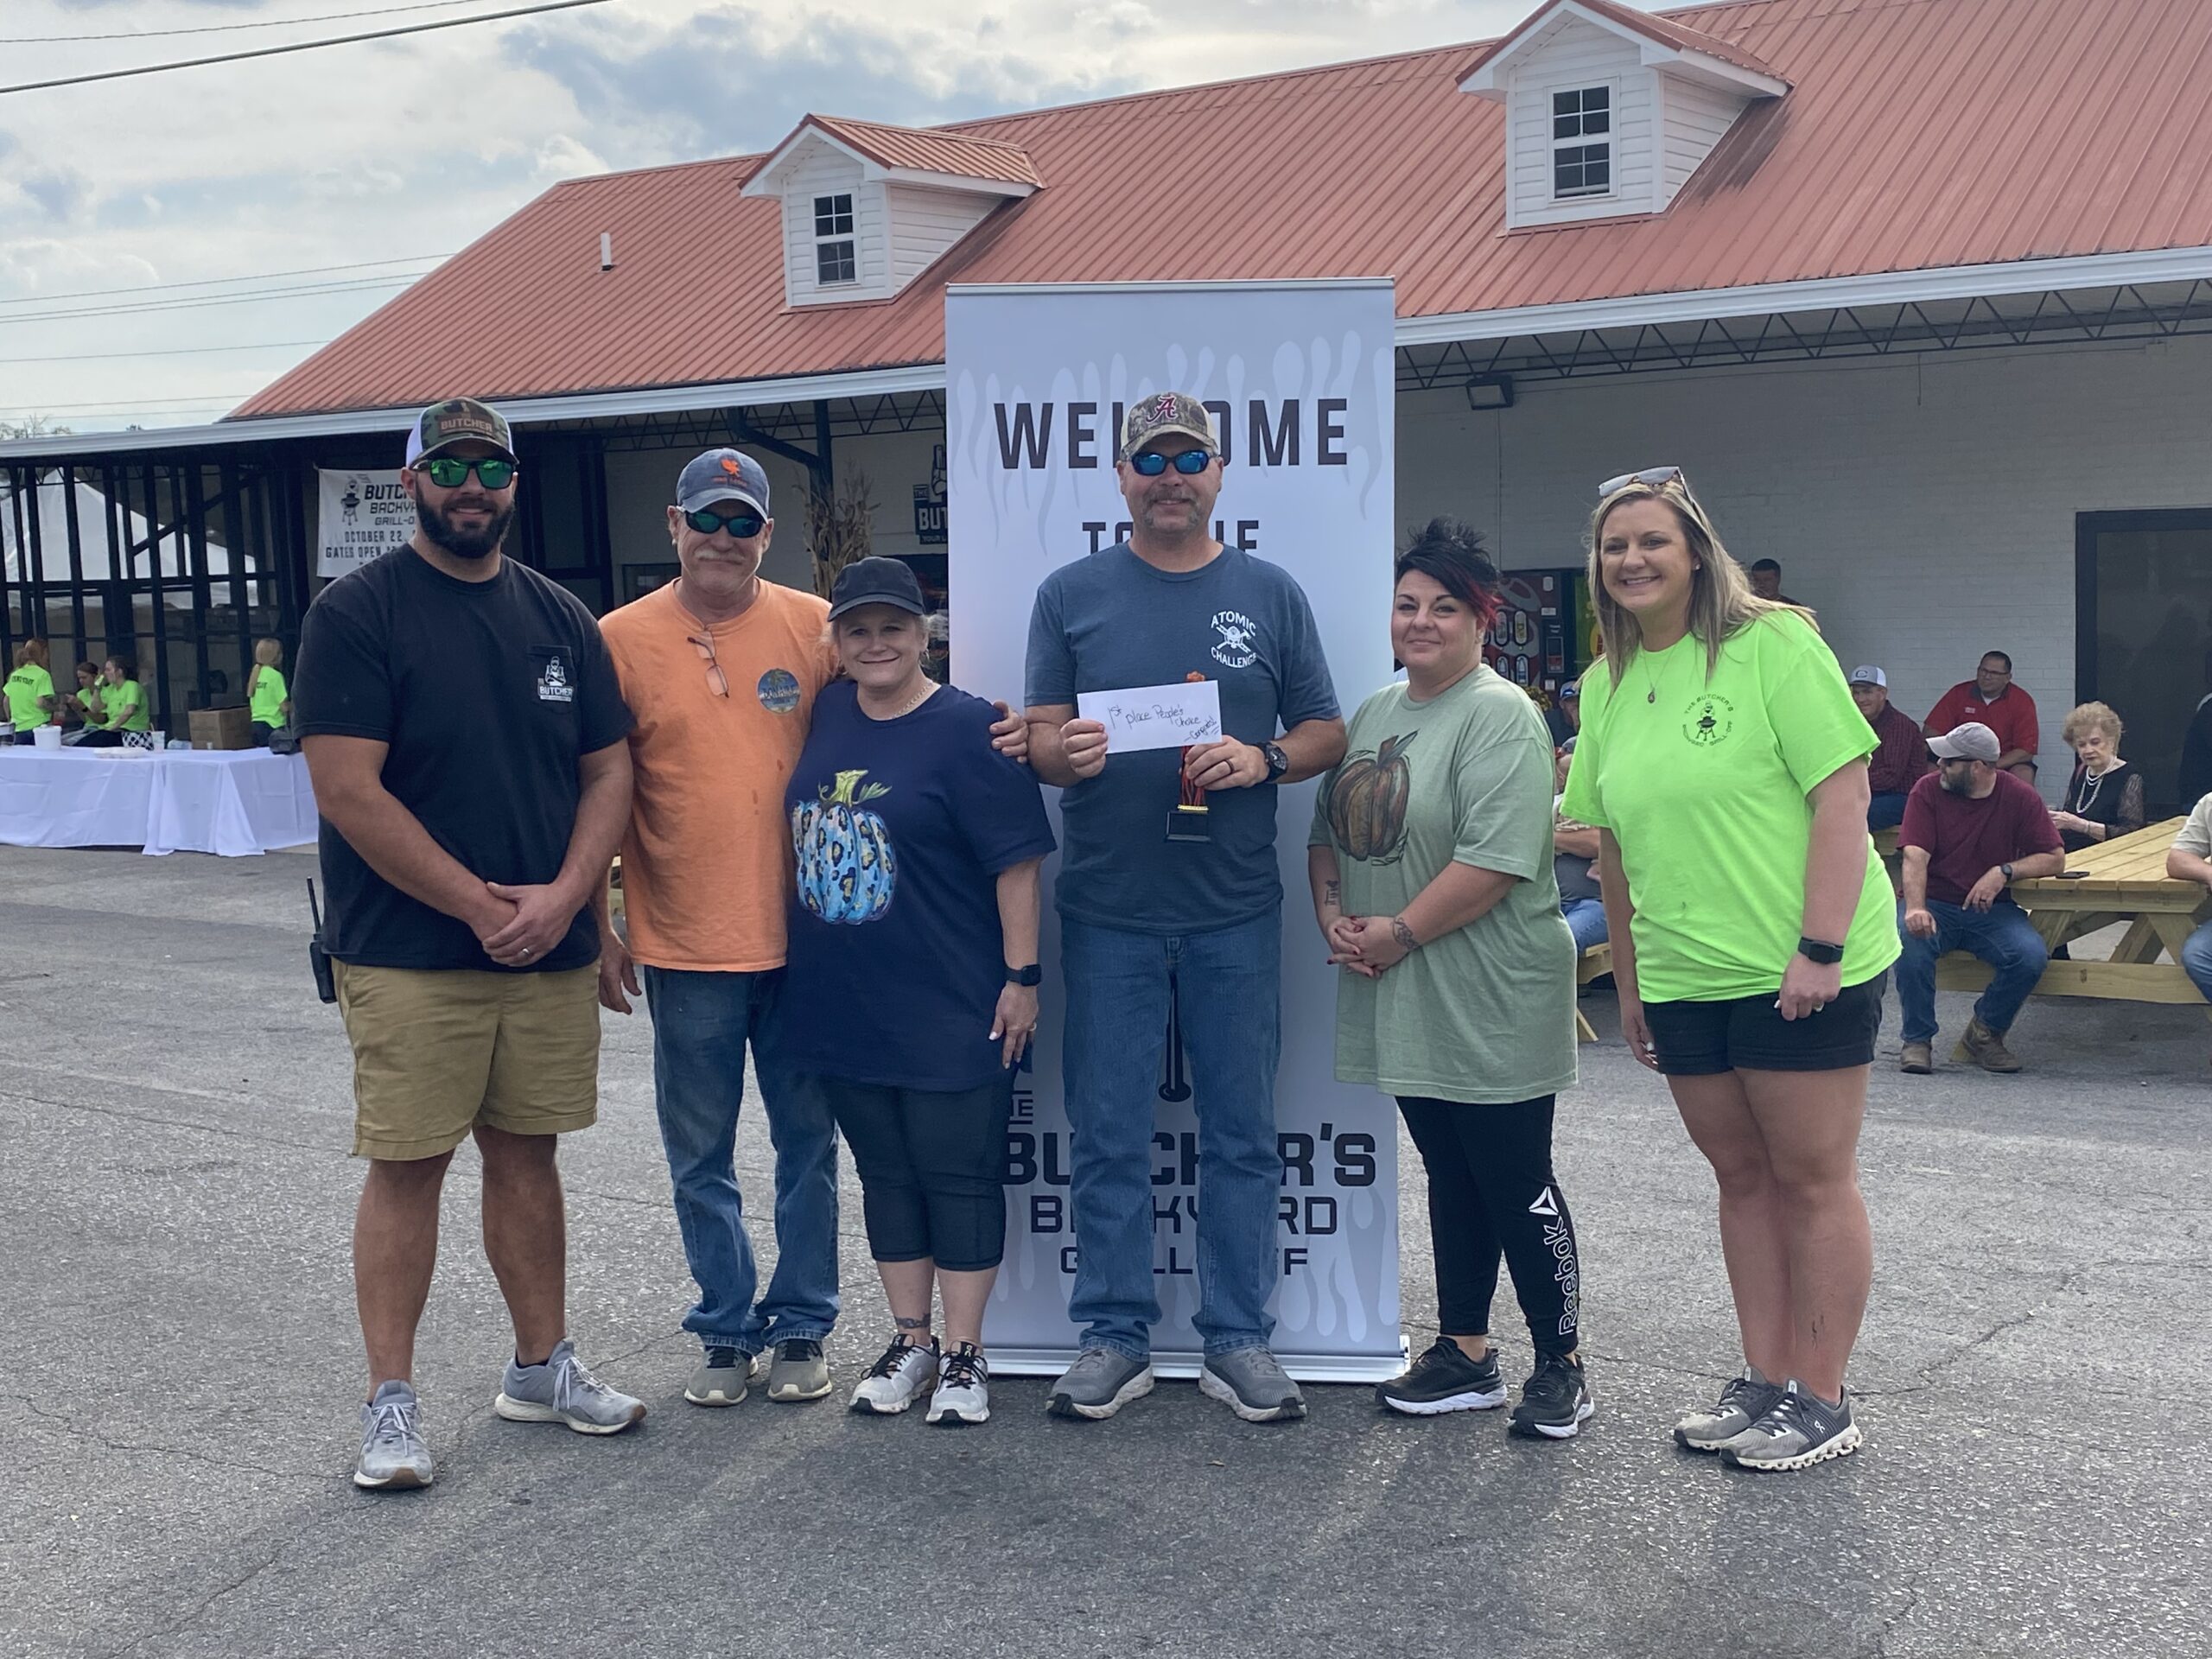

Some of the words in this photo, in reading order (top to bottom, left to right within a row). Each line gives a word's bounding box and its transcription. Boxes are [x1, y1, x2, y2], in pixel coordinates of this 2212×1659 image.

[441, 418, 493, 432] BUTCHER
[994, 398, 1347, 469] WELOME
[345, 531, 385, 543] OCTOBER
[326, 547, 354, 558] GATES
[358, 546, 381, 558] OPEN
[1211, 610, 1256, 637] ATOMIC
[1211, 646, 1257, 668] CHALLENGE
[1543, 1215, 1579, 1336] Reebok
